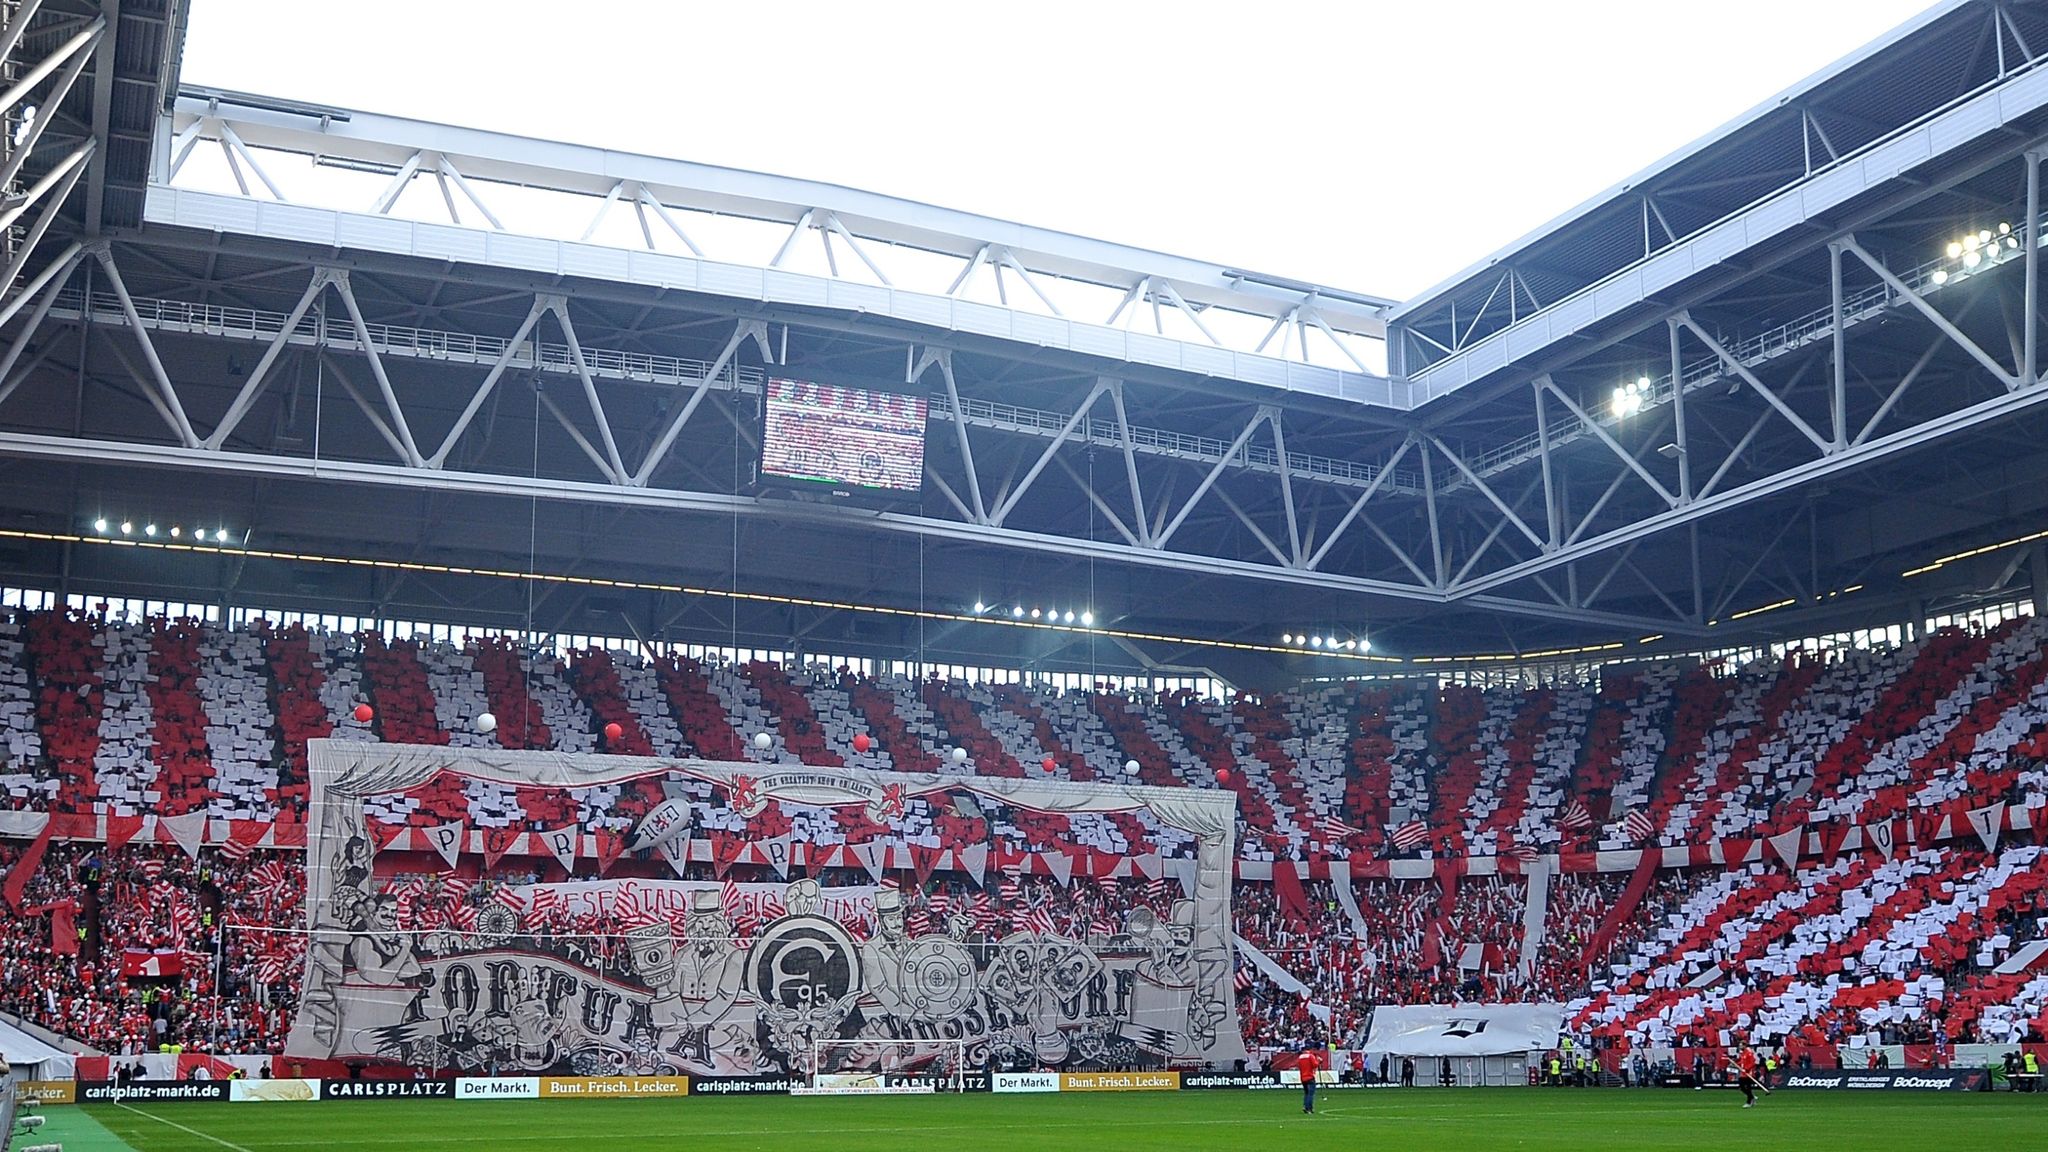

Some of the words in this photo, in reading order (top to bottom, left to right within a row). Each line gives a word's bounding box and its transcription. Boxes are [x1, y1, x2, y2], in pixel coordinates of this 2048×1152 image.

[763, 778, 777, 789] THE
[780, 775, 815, 785] GREATEST
[533, 886, 612, 919] DESE
[625, 881, 696, 917] STAD
[464, 1082, 487, 1094] Der
[490, 1082, 531, 1094] Markt.
[550, 1081, 585, 1094] Bunt.
[587, 1081, 631, 1094] Frisch.
[633, 1080, 679, 1093] Lecker.
[696, 1079, 805, 1094] carlsplatz-markt.de
[999, 1078, 1019, 1088] Der
[1020, 1077, 1053, 1088] Markt.
[1067, 1077, 1097, 1088] Bunt.
[1098, 1076, 1134, 1088] Frisch.
[1135, 1076, 1173, 1088] Lecker.
[1186, 1075, 1275, 1088] carlsplatz-markt.de
[1787, 1076, 1843, 1089] BoConcept
[1893, 1076, 1955, 1090] BoConcept
[85, 1085, 220, 1100] carlsplatz-markt.de
[329, 1083, 447, 1096] CARLSPLATZ
